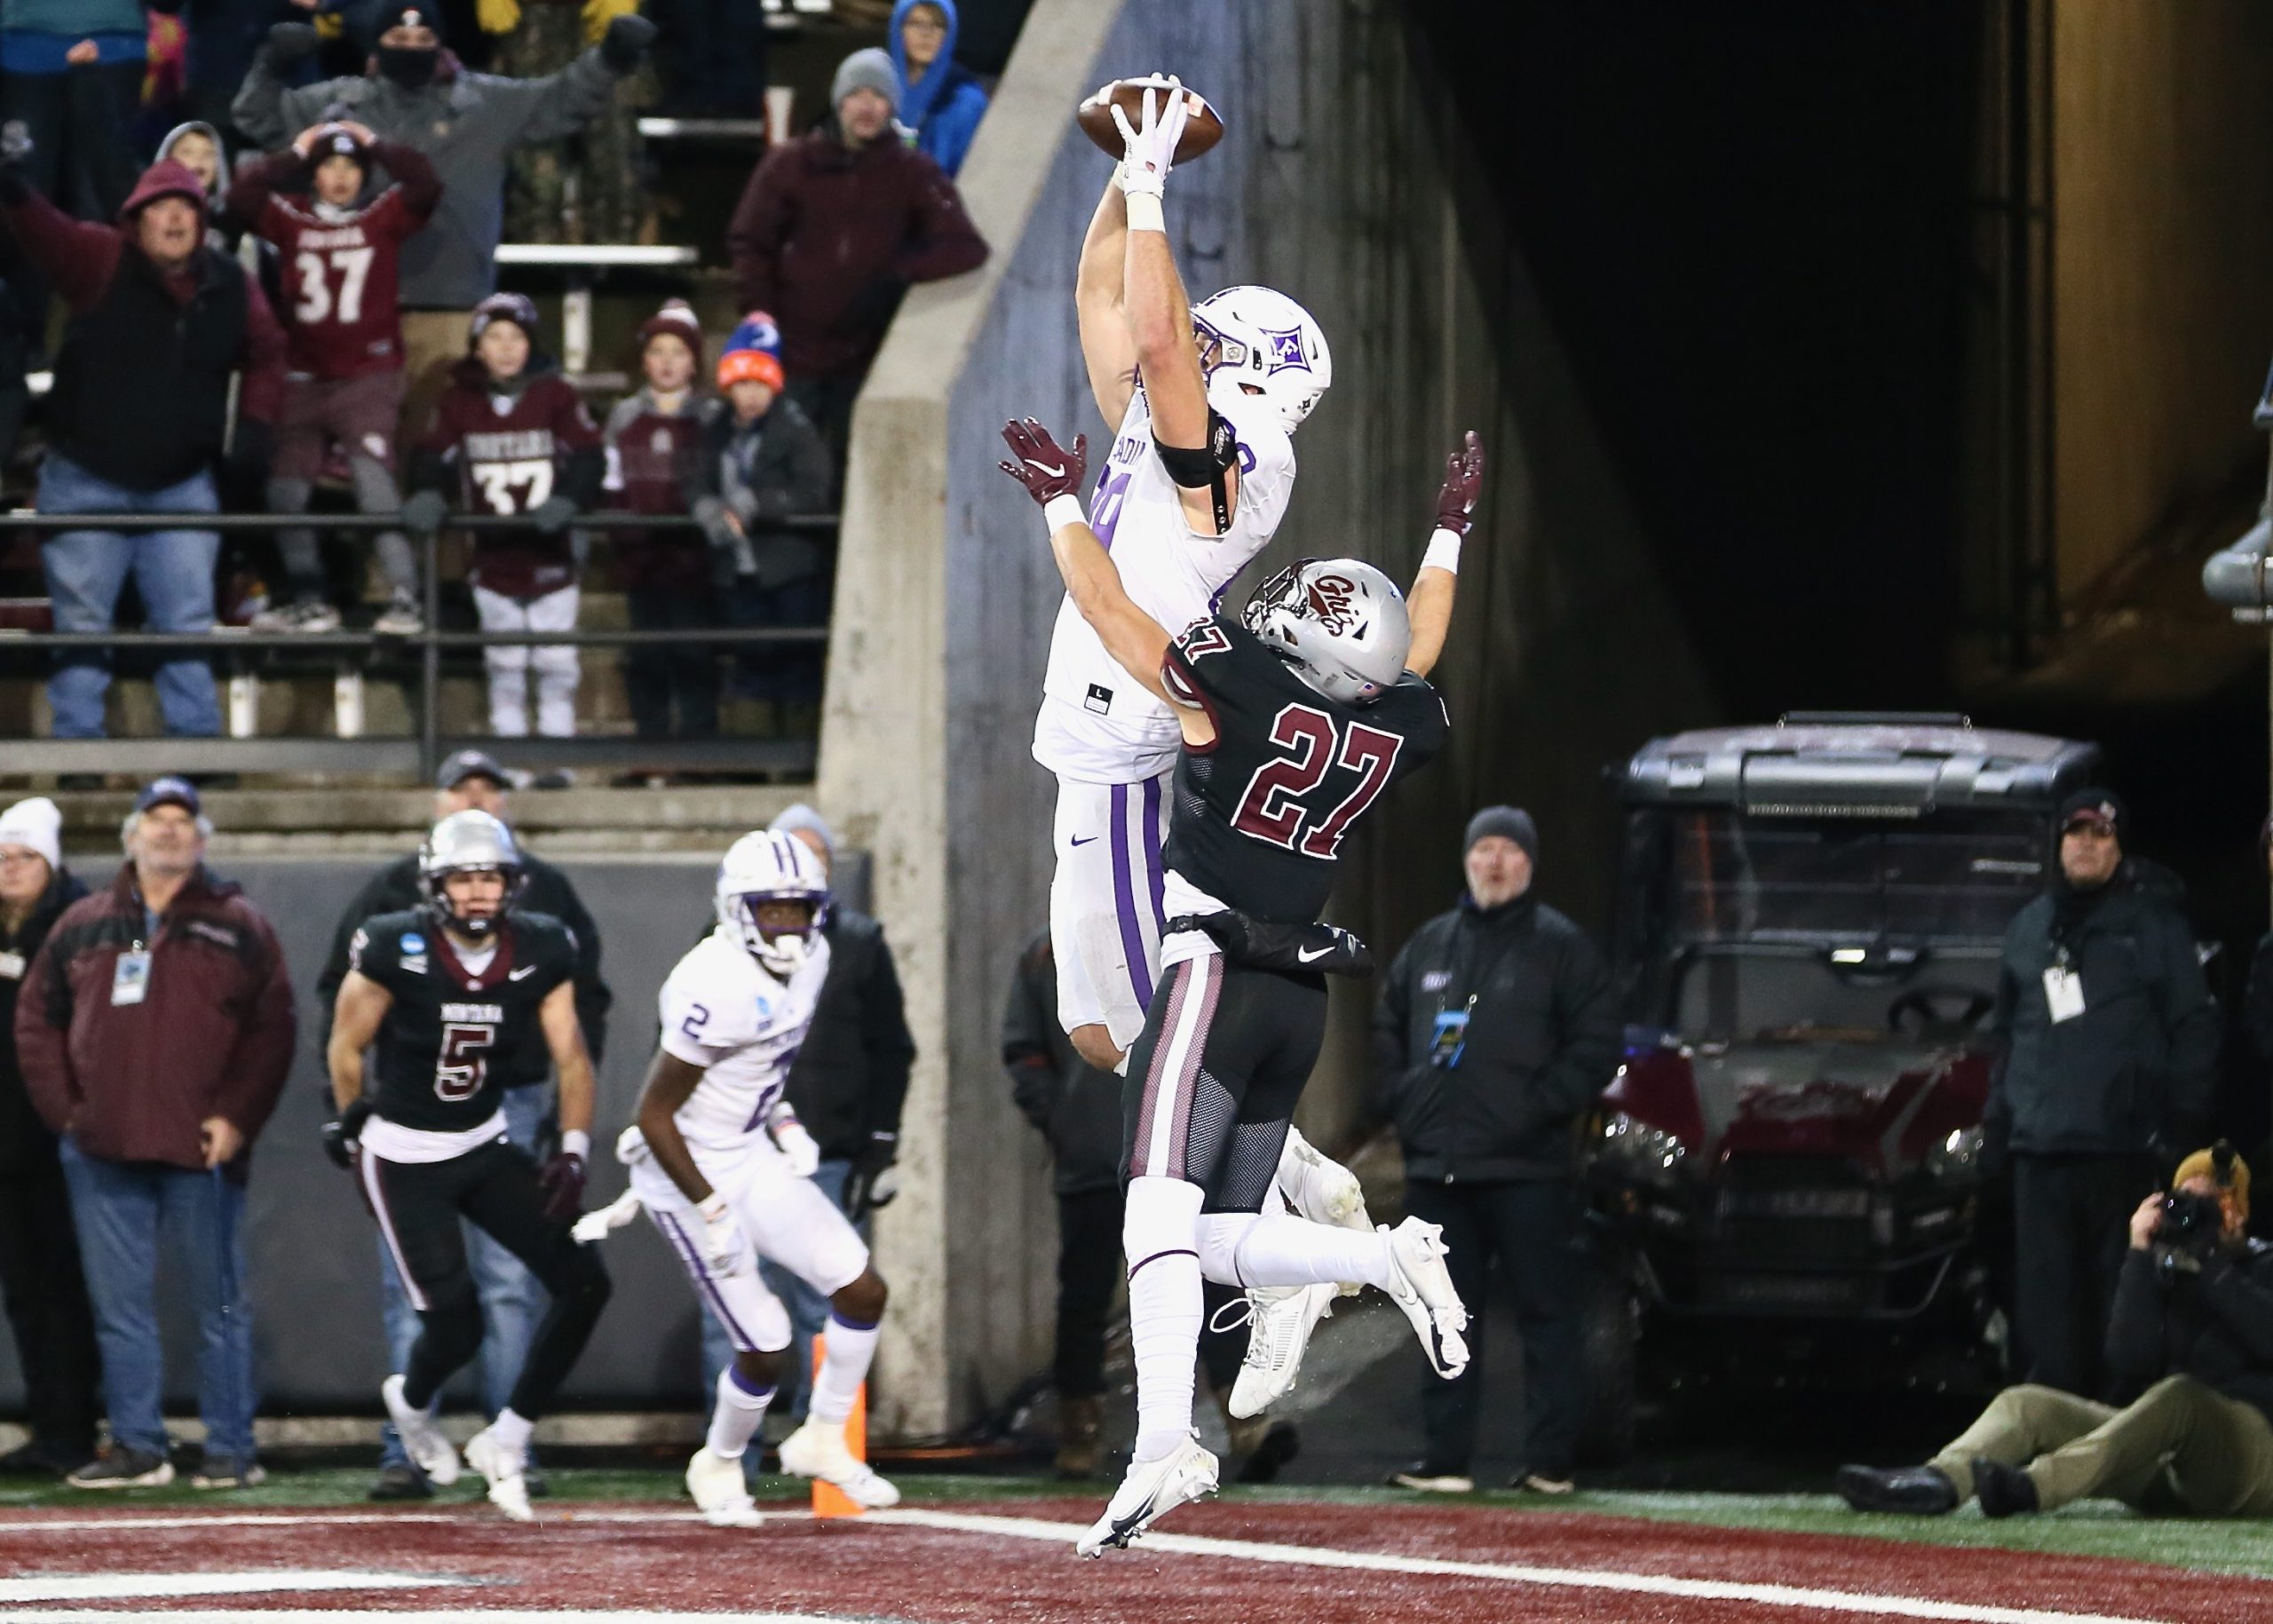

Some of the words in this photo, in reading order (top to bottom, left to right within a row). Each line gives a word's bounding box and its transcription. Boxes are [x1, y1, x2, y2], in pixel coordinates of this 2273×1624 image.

[294, 248, 376, 322] 37
[471, 461, 553, 516] 37
[1230, 701, 1405, 860] 27
[681, 1002, 709, 1040] 2
[433, 1023, 495, 1101] 5
